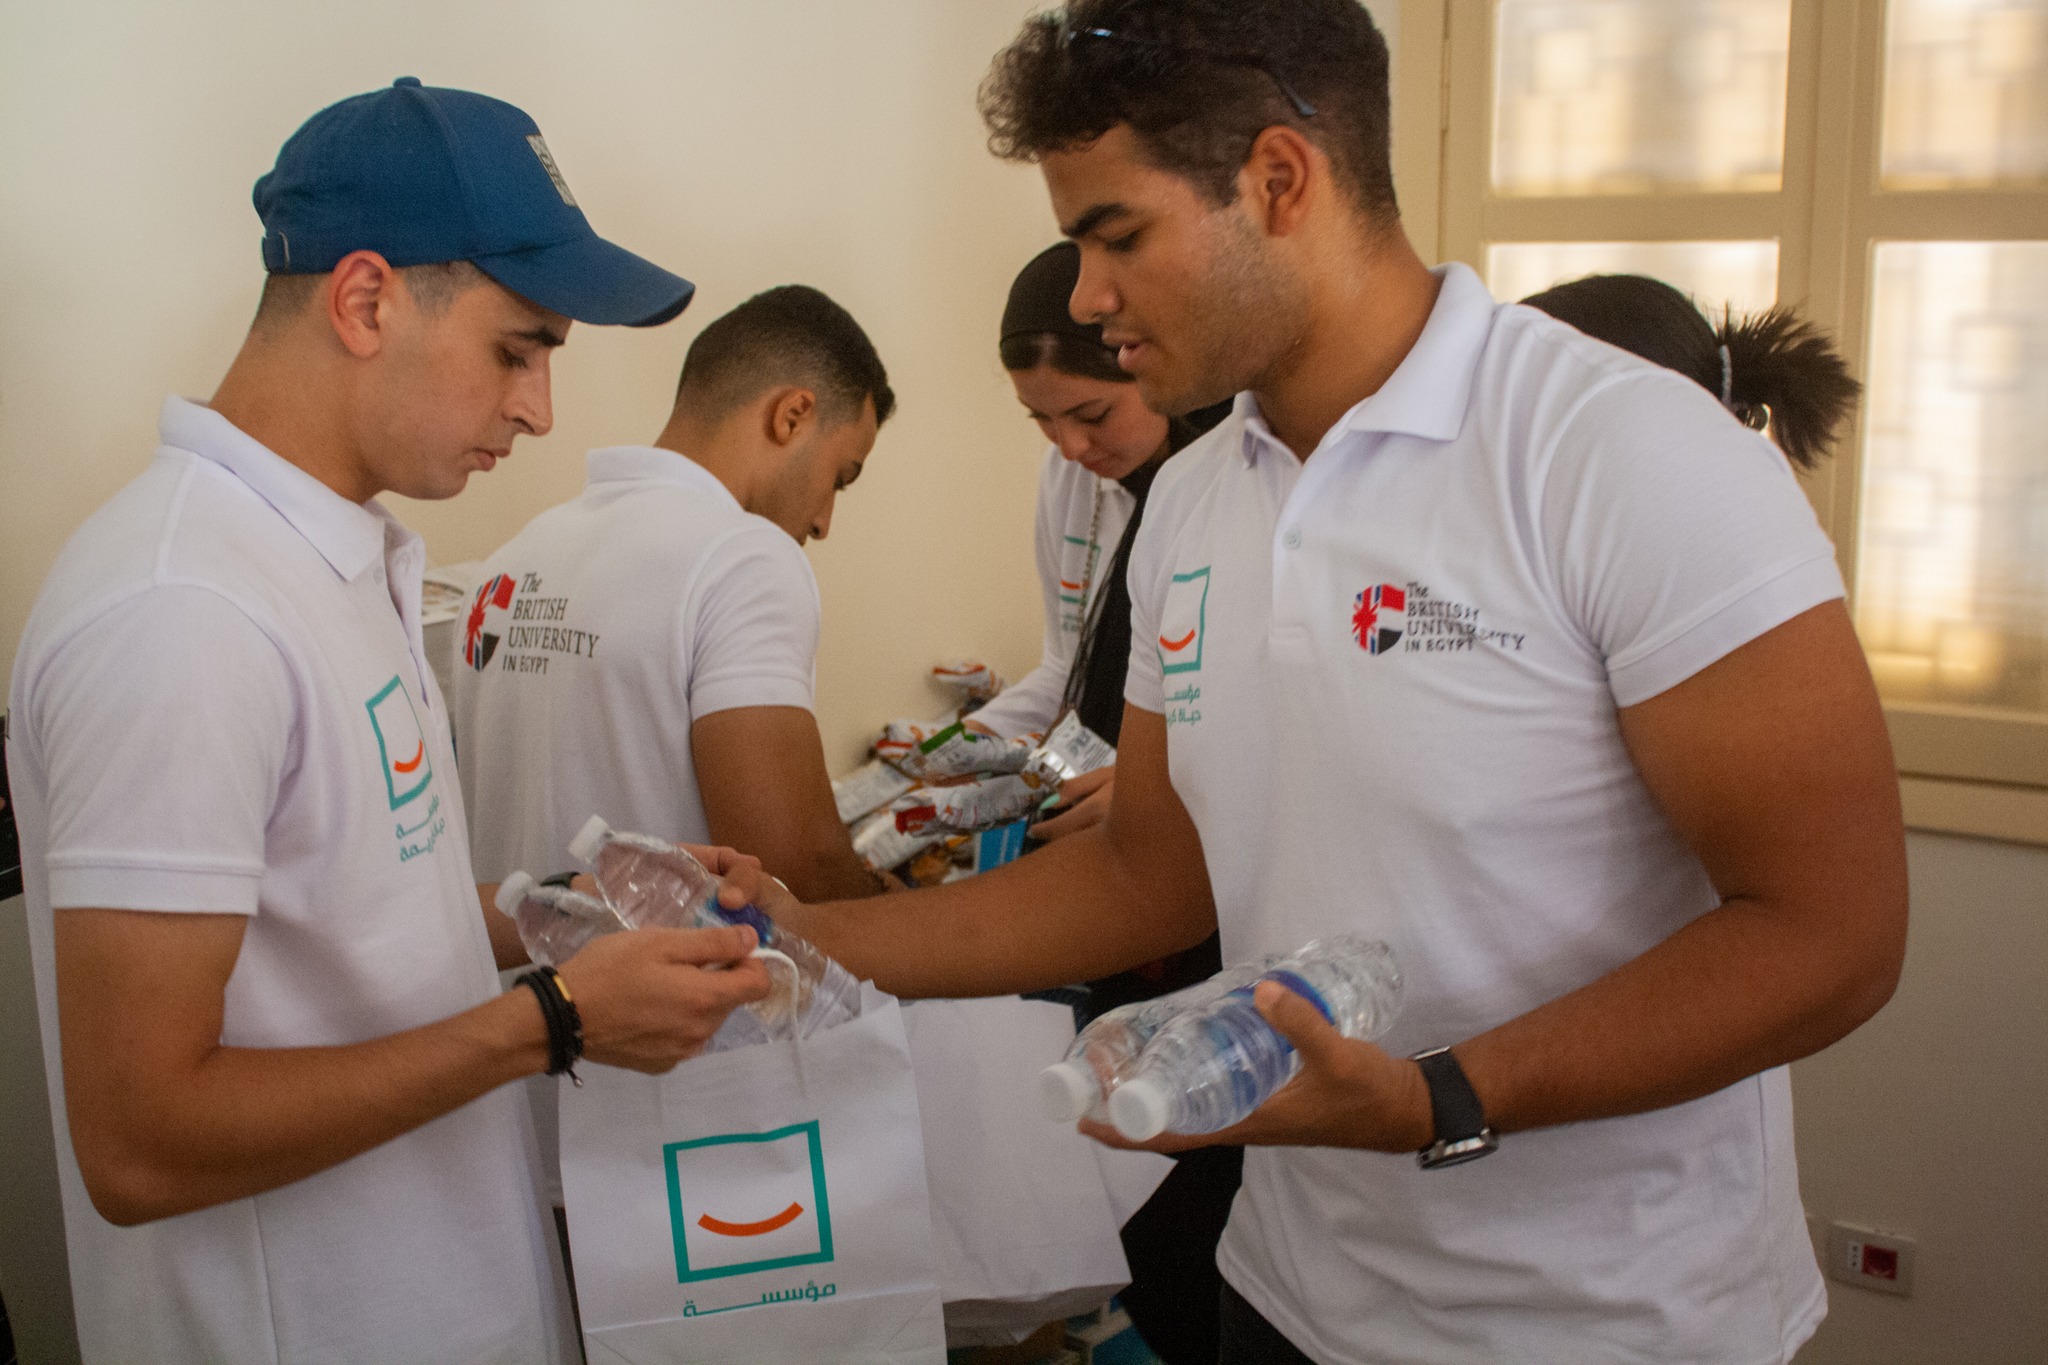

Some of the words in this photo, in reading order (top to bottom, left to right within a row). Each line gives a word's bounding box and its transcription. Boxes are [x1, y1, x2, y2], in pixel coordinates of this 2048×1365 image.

[520, 572, 542, 593] The
[1406, 582, 1429, 598] The
[512, 598, 568, 621] BRITISH
[1406, 600, 1480, 621] BRITISH
[507, 626, 600, 658] UNIVERSITY
[1405, 639, 1421, 652] IN
[1426, 637, 1474, 652] EGYPT
[502, 655, 516, 673] IN
[519, 656, 549, 675] EGYPT
[683, 1280, 837, 1318] مؤسسة
